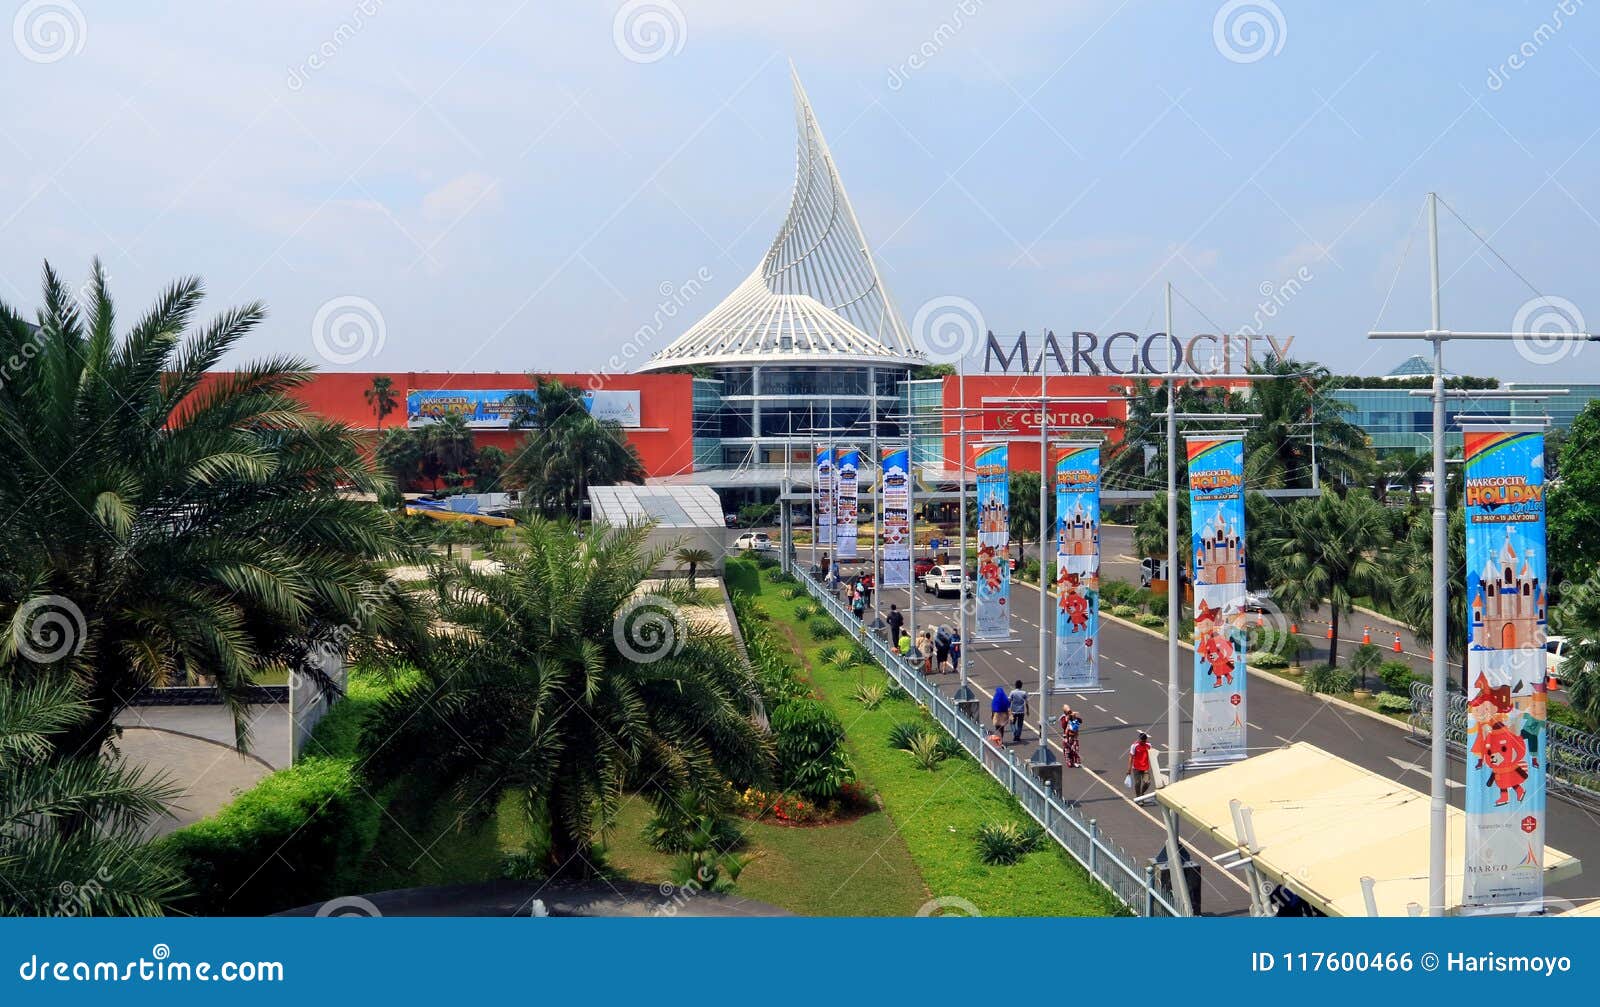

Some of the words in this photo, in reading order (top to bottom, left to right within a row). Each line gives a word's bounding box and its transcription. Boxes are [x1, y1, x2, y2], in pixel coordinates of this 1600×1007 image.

[984, 329, 1295, 375] MARGOCITY
[1020, 412, 1094, 425] CENTRO
[1190, 475, 1242, 490] HOLIDAY
[1466, 476, 1527, 488] MARGOCITY
[1466, 485, 1544, 507] HOLIDAY
